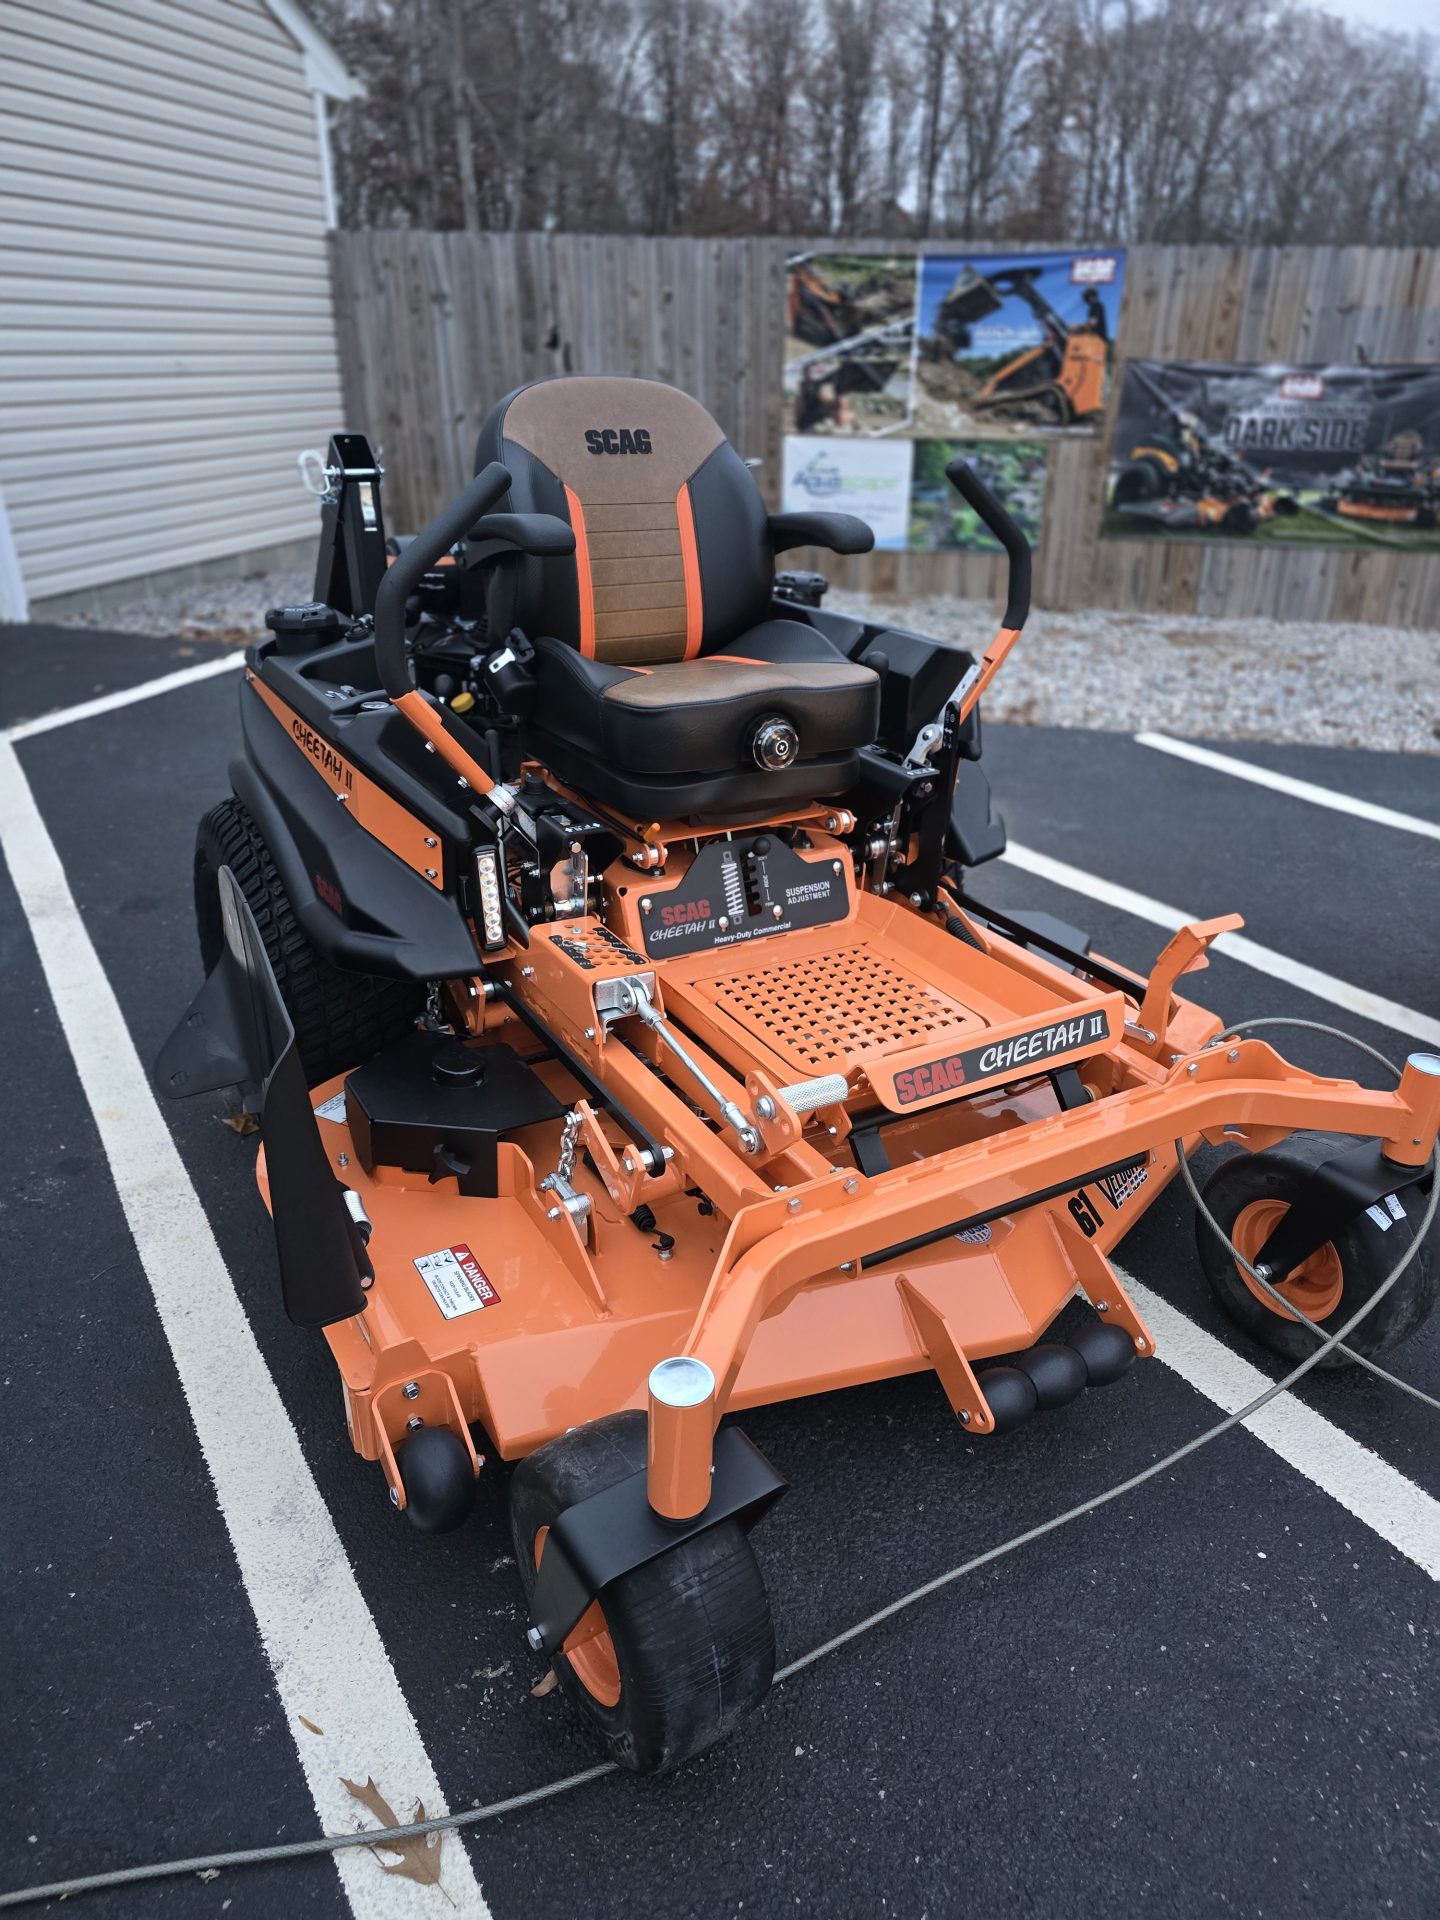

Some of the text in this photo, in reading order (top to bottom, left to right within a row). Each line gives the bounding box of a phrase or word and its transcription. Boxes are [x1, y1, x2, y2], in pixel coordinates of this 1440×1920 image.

[584, 428, 652, 455] SCAG
[1223, 416, 1366, 449] DARK SIDE
[291, 719, 352, 790] CHEETAH II
[785, 881, 830, 897] SUSPENSION
[787, 889, 831, 905] ADJUSTMENT
[660, 899, 712, 926] SCAG
[649, 919, 716, 942] CHEETAH II
[714, 921, 791, 945] Heavy-Duty Commercial
[979, 1015, 1103, 1073] CHEETAH II
[895, 1057, 966, 1101] SCAG
[1067, 1188, 1105, 1238] 61
[462, 1262, 493, 1300] DANGER
